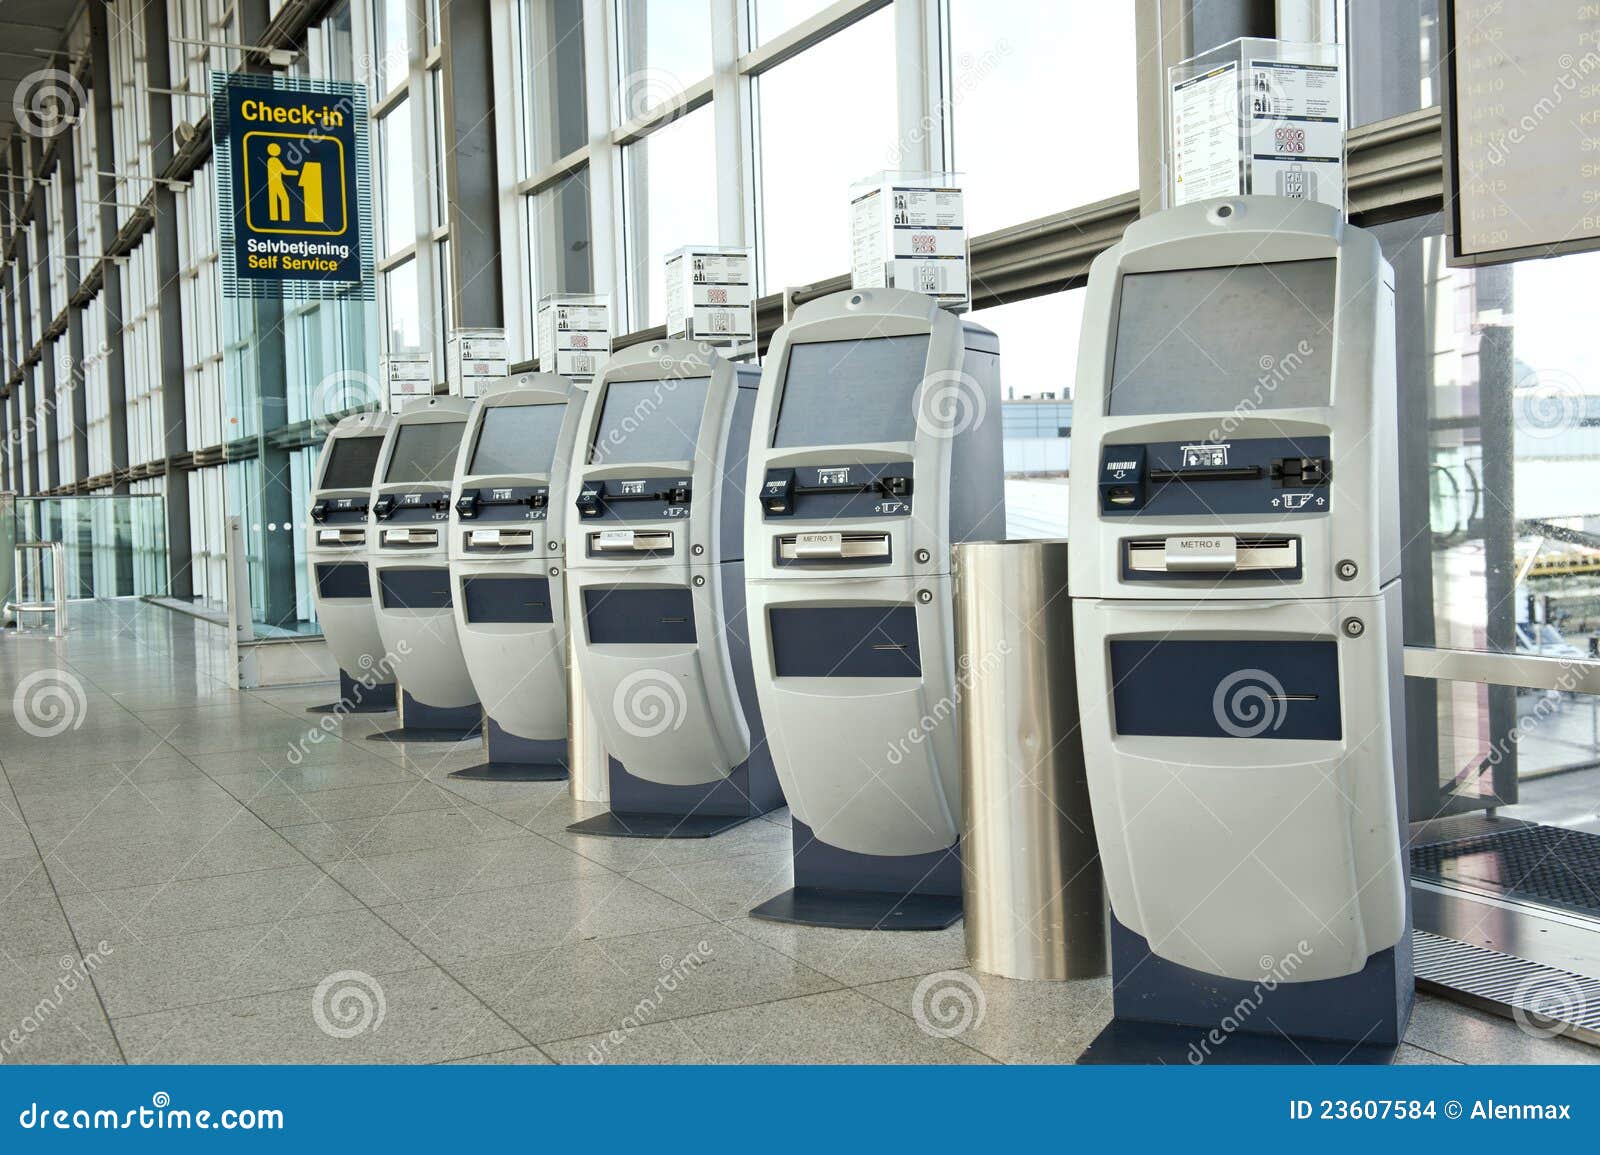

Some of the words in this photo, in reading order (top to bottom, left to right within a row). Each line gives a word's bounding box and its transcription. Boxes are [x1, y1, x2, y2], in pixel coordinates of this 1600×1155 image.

[241, 100, 343, 127] Check-in
[247, 239, 349, 259] Selvbetjening
[248, 255, 278, 269] Self
[282, 256, 338, 271] Service
[1180, 540, 1212, 548] METRO
[1214, 540, 1221, 548] 6
